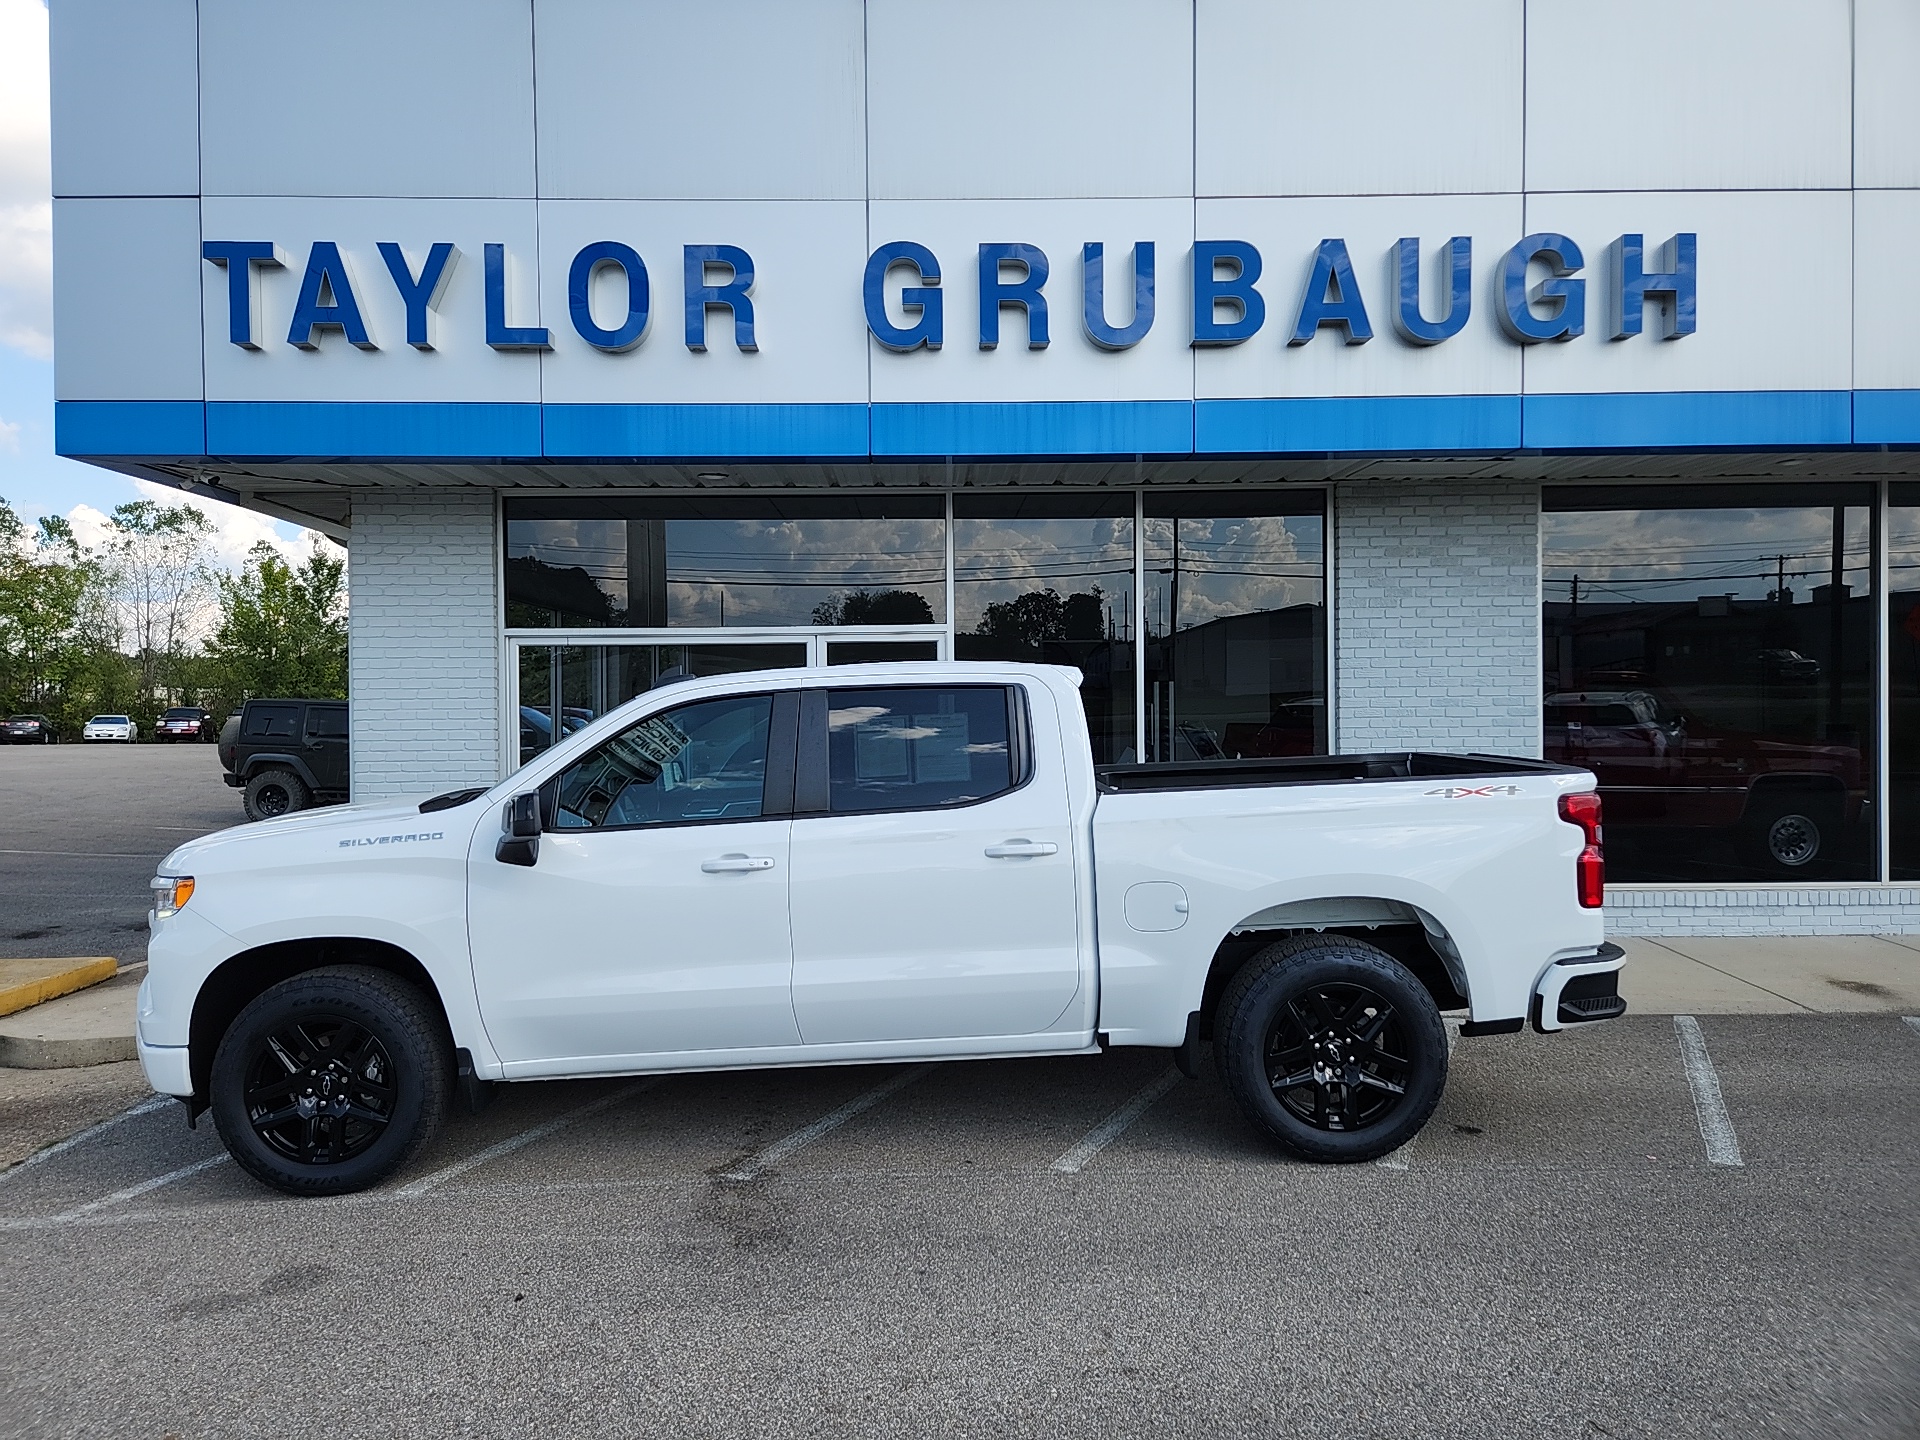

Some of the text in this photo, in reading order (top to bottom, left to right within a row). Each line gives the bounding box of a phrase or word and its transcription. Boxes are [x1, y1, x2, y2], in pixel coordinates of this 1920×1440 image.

[203, 232, 1699, 353] TAYLOR GRUBAUGH
[338, 831, 444, 848] SILVERADO
